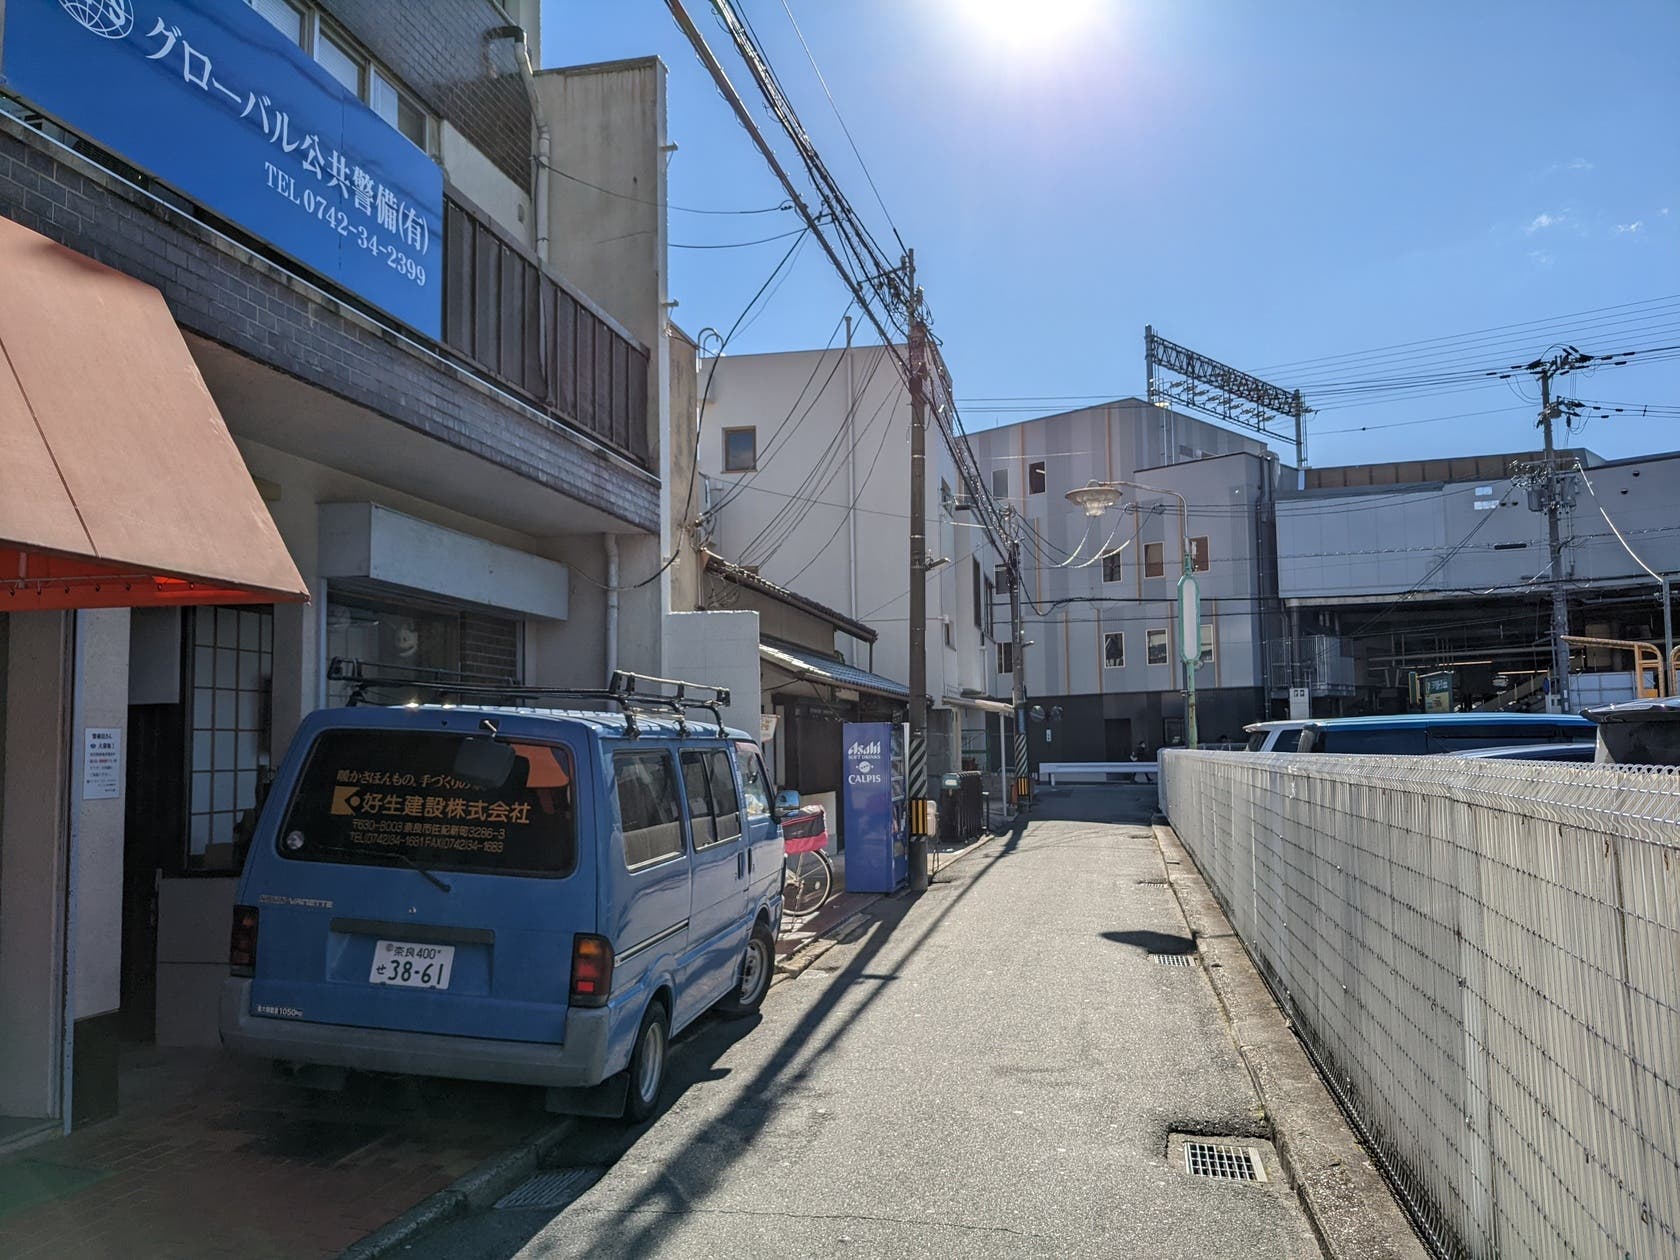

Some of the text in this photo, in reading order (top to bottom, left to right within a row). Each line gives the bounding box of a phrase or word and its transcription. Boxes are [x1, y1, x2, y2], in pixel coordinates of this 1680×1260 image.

[145, 16, 429, 256] グローバル公共警備(有)
[303, 189, 427, 287] 0742-34-2399
[848, 741, 881, 755] Asahi
[848, 774, 881, 785] CALPIS
[361, 791, 532, 825] 好生建設株式会社
[375, 959, 444, 985] せ 38-61
